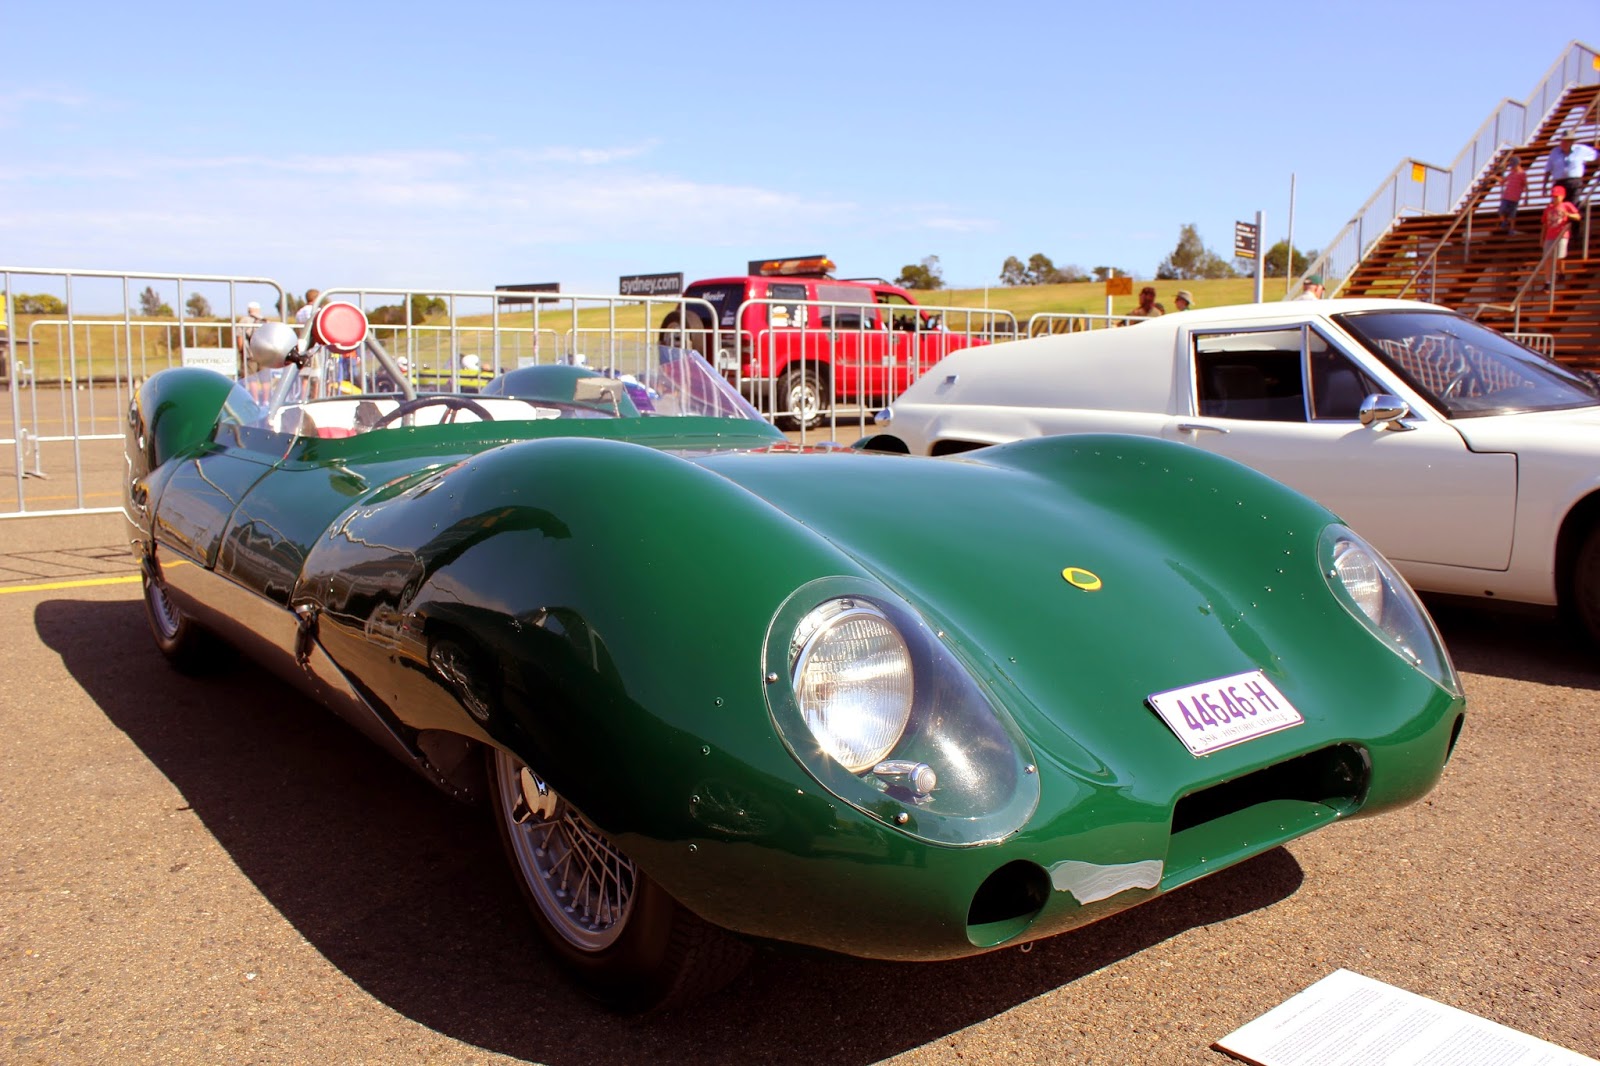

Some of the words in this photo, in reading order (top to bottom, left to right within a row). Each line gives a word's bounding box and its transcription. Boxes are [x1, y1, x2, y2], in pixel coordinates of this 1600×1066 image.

[621, 276, 680, 295] sydney.com
[1222, 723, 1257, 737] HISTORIC
[1257, 713, 1288, 726] VEHICLE
